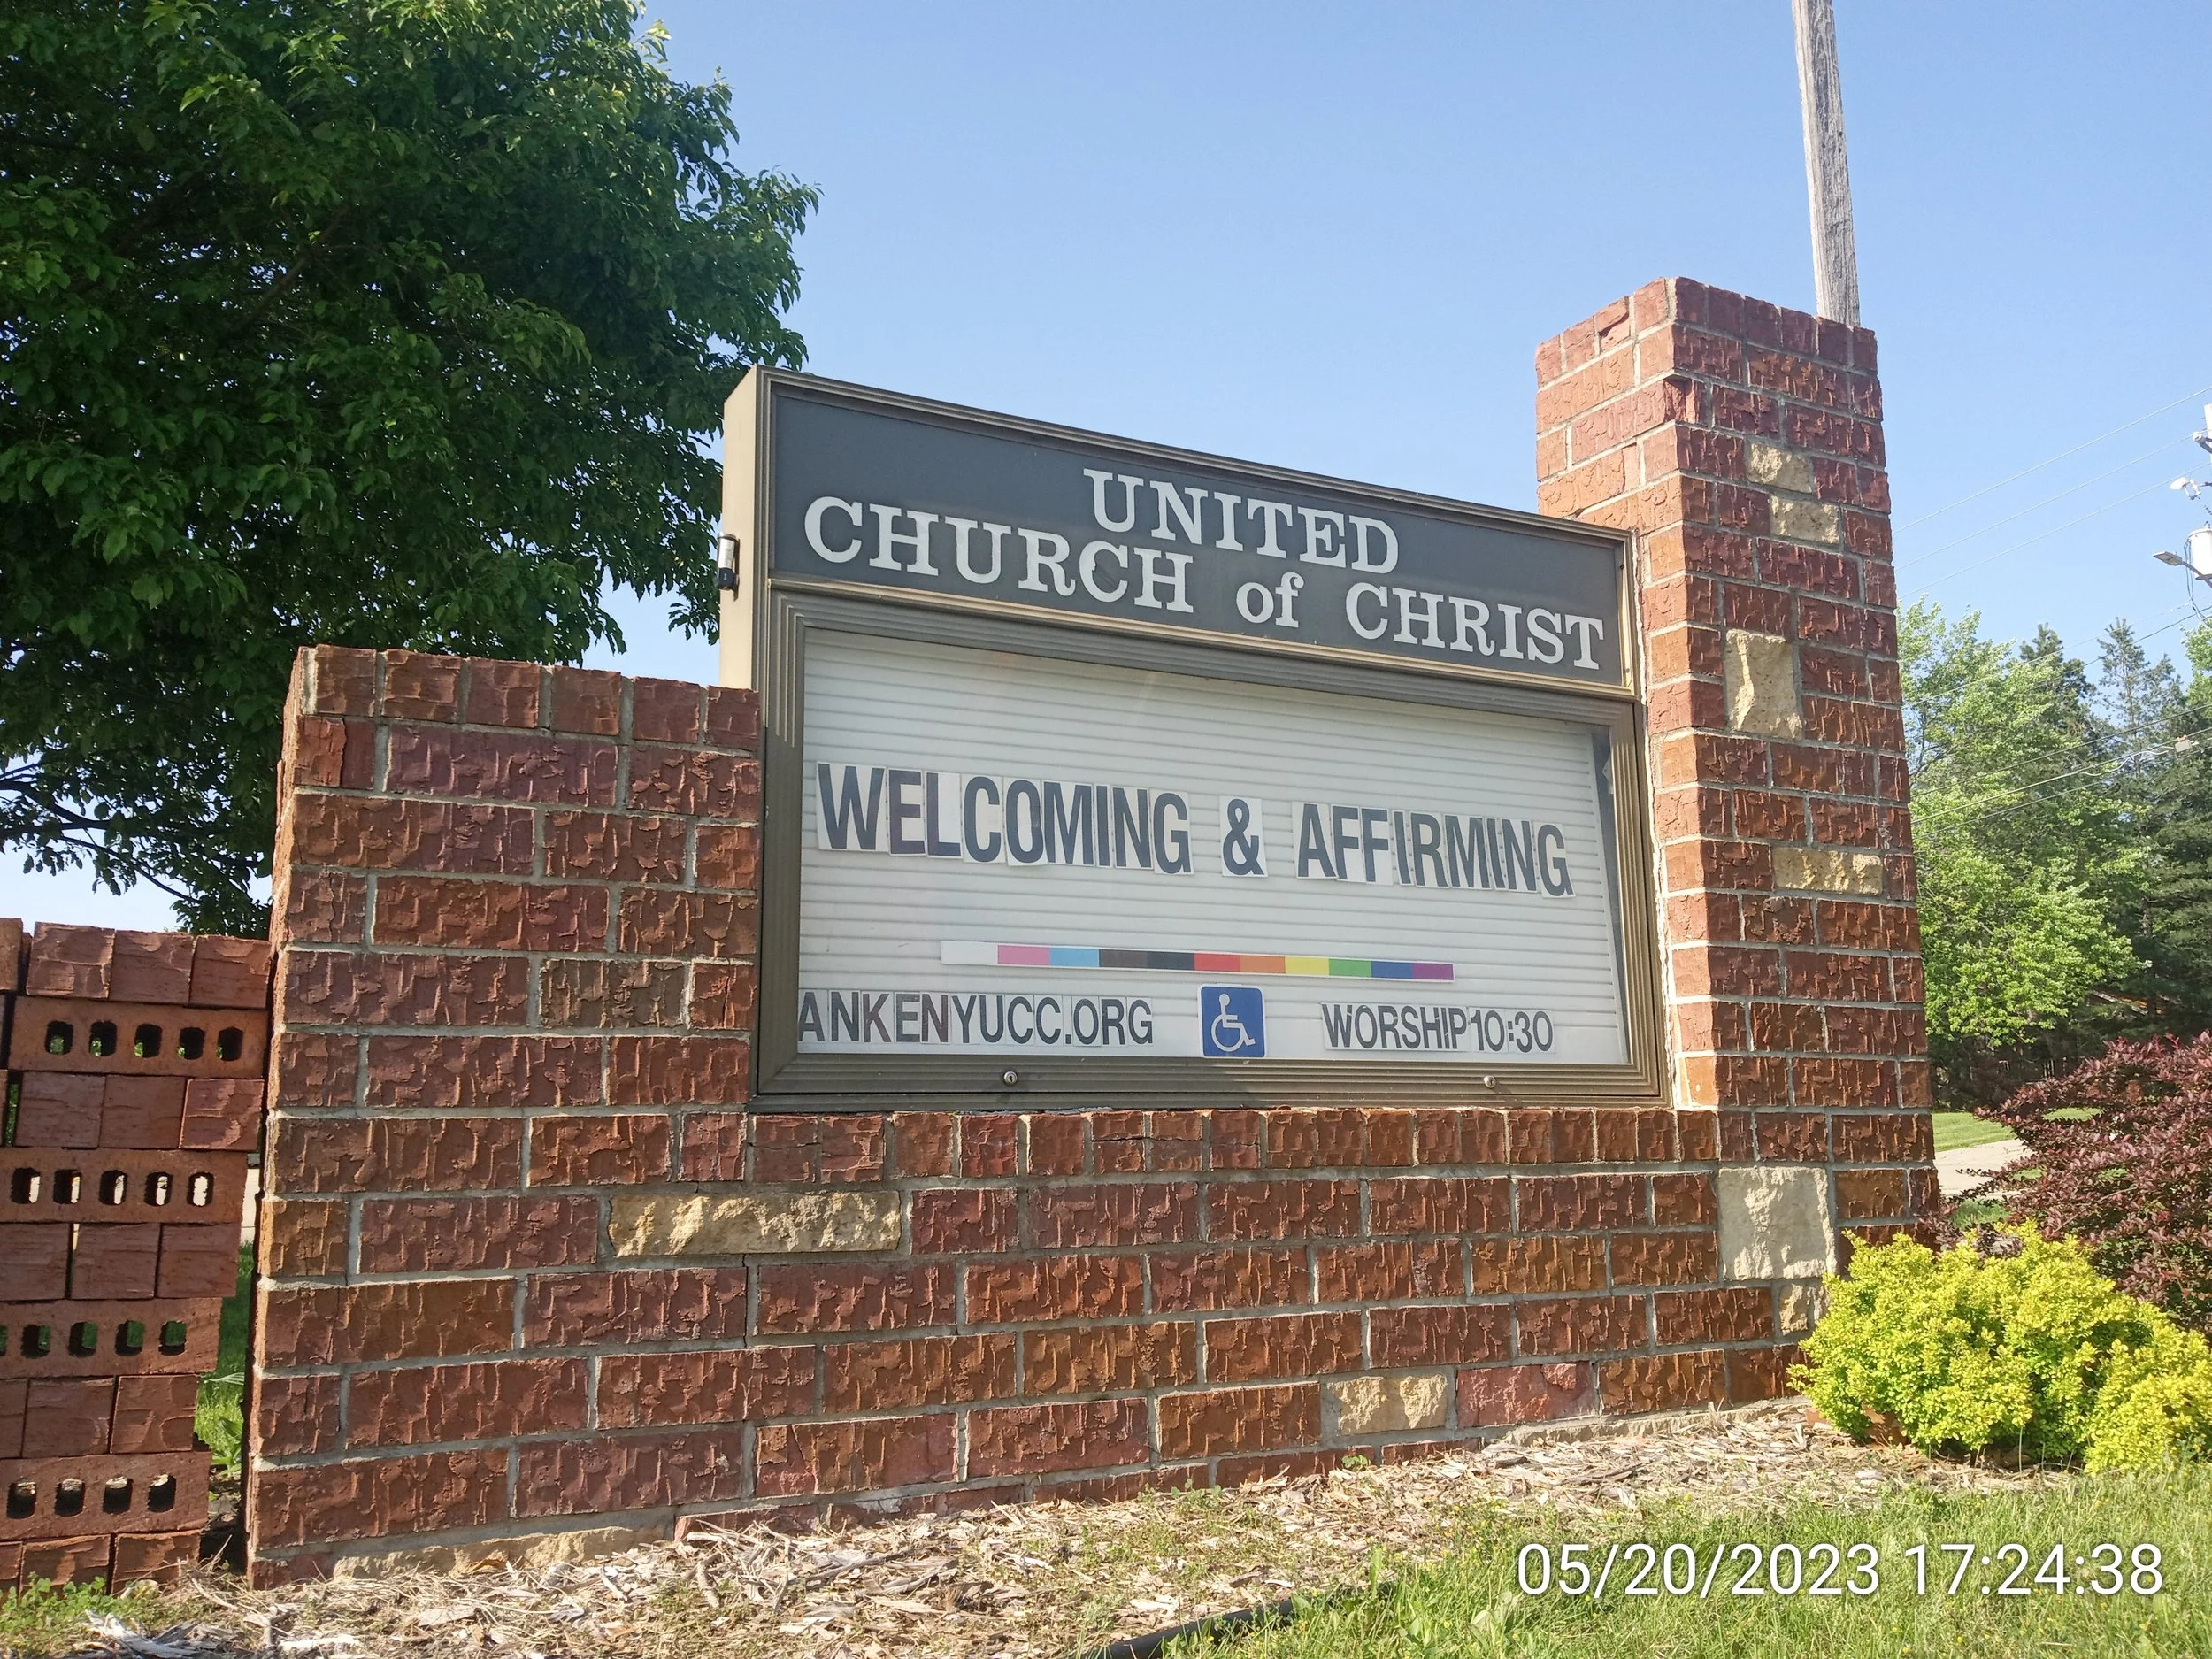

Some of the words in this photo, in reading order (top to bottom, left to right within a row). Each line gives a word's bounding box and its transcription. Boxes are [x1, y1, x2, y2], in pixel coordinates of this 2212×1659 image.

[1083, 468, 1399, 574] UNITED
[804, 496, 1194, 613] CHURCH
[1235, 572, 1304, 628] of
[1346, 582, 1604, 671] CHRIST
[818, 763, 1192, 874] WELCOMING
[1222, 798, 1264, 875] &
[1297, 803, 1573, 896] AFFIRMING
[798, 991, 1153, 1045] ANKENYUCC.ORG
